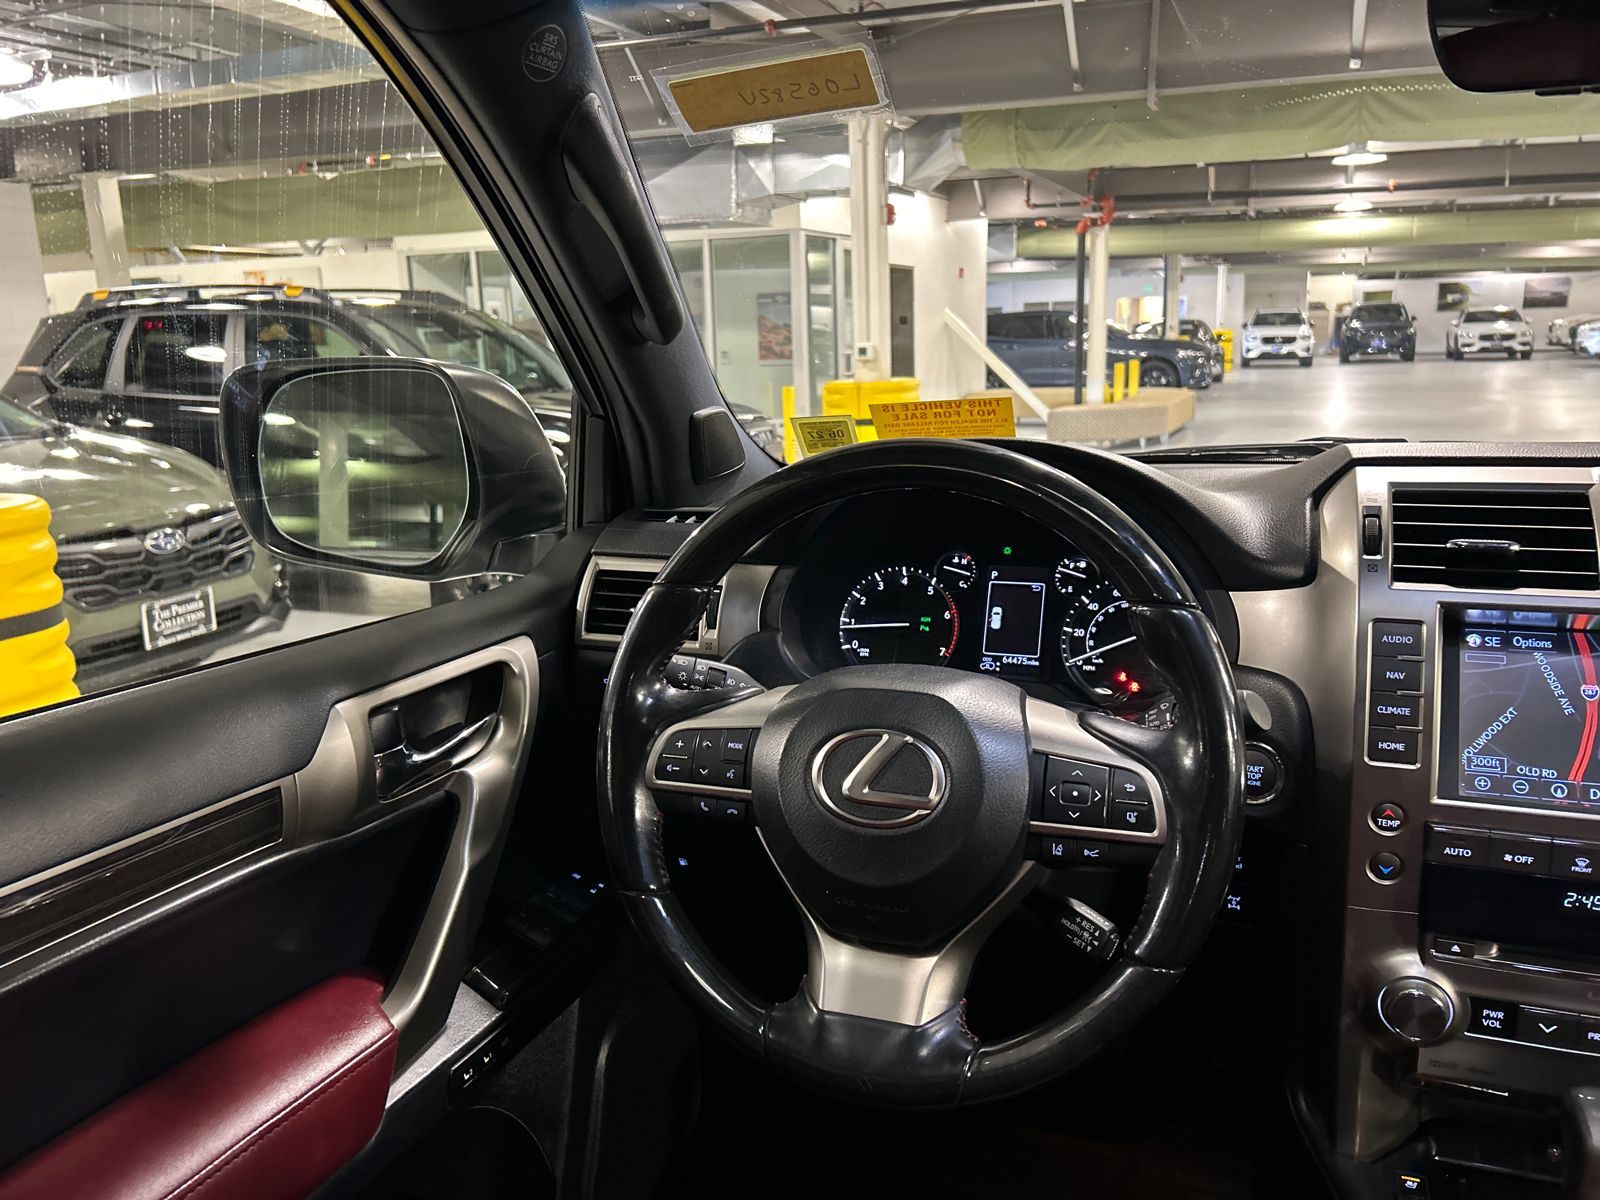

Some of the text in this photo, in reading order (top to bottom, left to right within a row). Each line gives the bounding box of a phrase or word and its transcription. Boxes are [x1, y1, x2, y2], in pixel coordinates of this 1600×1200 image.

[543, 32, 559, 45] SRS
[530, 42, 563, 60] CURTAIN
[528, 53, 559, 70] AIRBAG
[901, 576, 908, 585] 4
[991, 570, 998, 580] P
[877, 581, 884, 590] 3
[927, 586, 934, 595] 5
[860, 596, 866, 605] 2
[152, 599, 205, 622] THE PREMIER
[1087, 602, 1099, 611] 40
[944, 610, 951, 620] 6
[153, 609, 206, 633] COLLECTION
[1073, 628, 1085, 637] 20
[852, 640, 859, 649] 0
[1381, 635, 1414, 645] AUDIO
[1484, 636, 1501, 647] SE
[1512, 636, 1553, 649] Options
[939, 647, 946, 656] 7
[1002, 656, 1028, 665] 64475
[1386, 671, 1406, 680] NAV
[1533, 652, 1576, 716] WOODSIDE AVE
[1377, 705, 1411, 716] CLIMATE
[1498, 706, 1518, 725] EXT
[1378, 741, 1406, 751] HOME
[1470, 756, 1500, 767] 300ft
[1246, 764, 1265, 773] TART
[1516, 765, 1559, 779] OLD RD
[1246, 772, 1262, 780] TOP
[1376, 817, 1401, 828] TEMP
[1443, 846, 1472, 857] AUTO
[1514, 854, 1535, 865] OFF
[1570, 865, 1593, 874] FRONT
[1081, 905, 1105, 924] CANCEL
[1081, 920, 1095, 933] RES
[1072, 936, 1087, 949] SET
[1482, 1009, 1504, 1019] PWR
[1481, 1018, 1502, 1029] VOL
